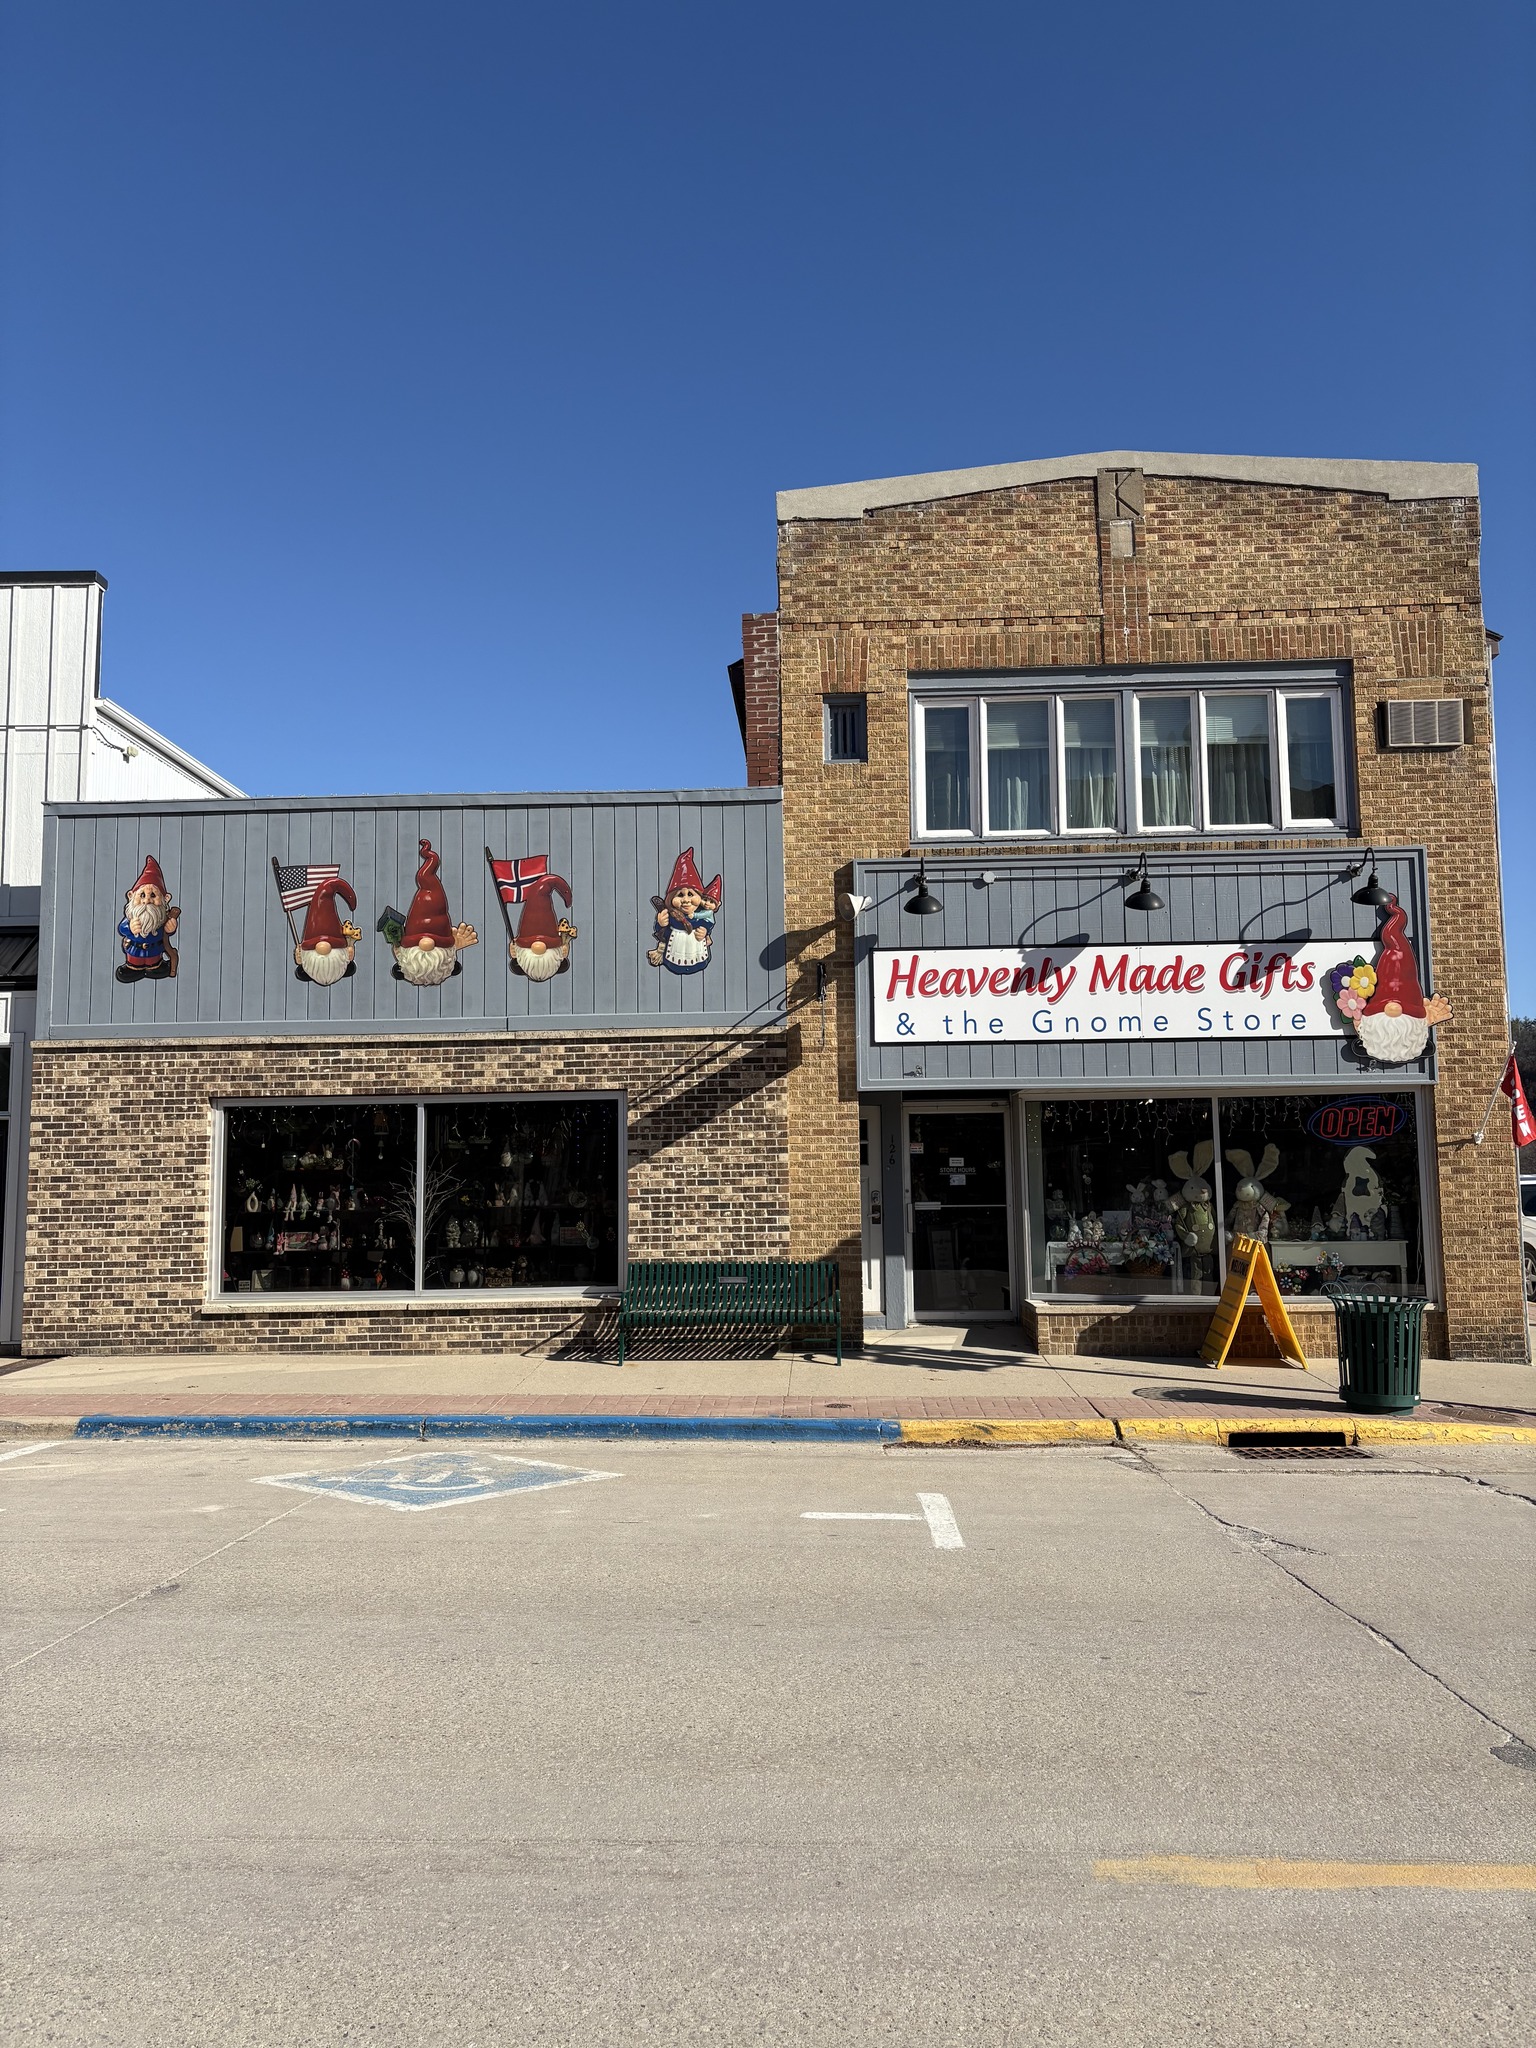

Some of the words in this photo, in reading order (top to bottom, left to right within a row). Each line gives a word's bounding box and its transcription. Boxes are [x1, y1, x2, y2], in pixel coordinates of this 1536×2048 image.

[1104, 467, 1141, 518] K
[886, 955, 1077, 1005] Heavenly
[1088, 954, 1206, 995] Made
[1219, 952, 1316, 1000] Gifts
[896, 1012, 916, 1036] &
[942, 1010, 1004, 1035] the
[1032, 1009, 1169, 1034] Gnome
[1197, 1007, 1307, 1032] Store
[1320, 1106, 1398, 1138] OPEN
[888, 1134, 897, 1165] 126
